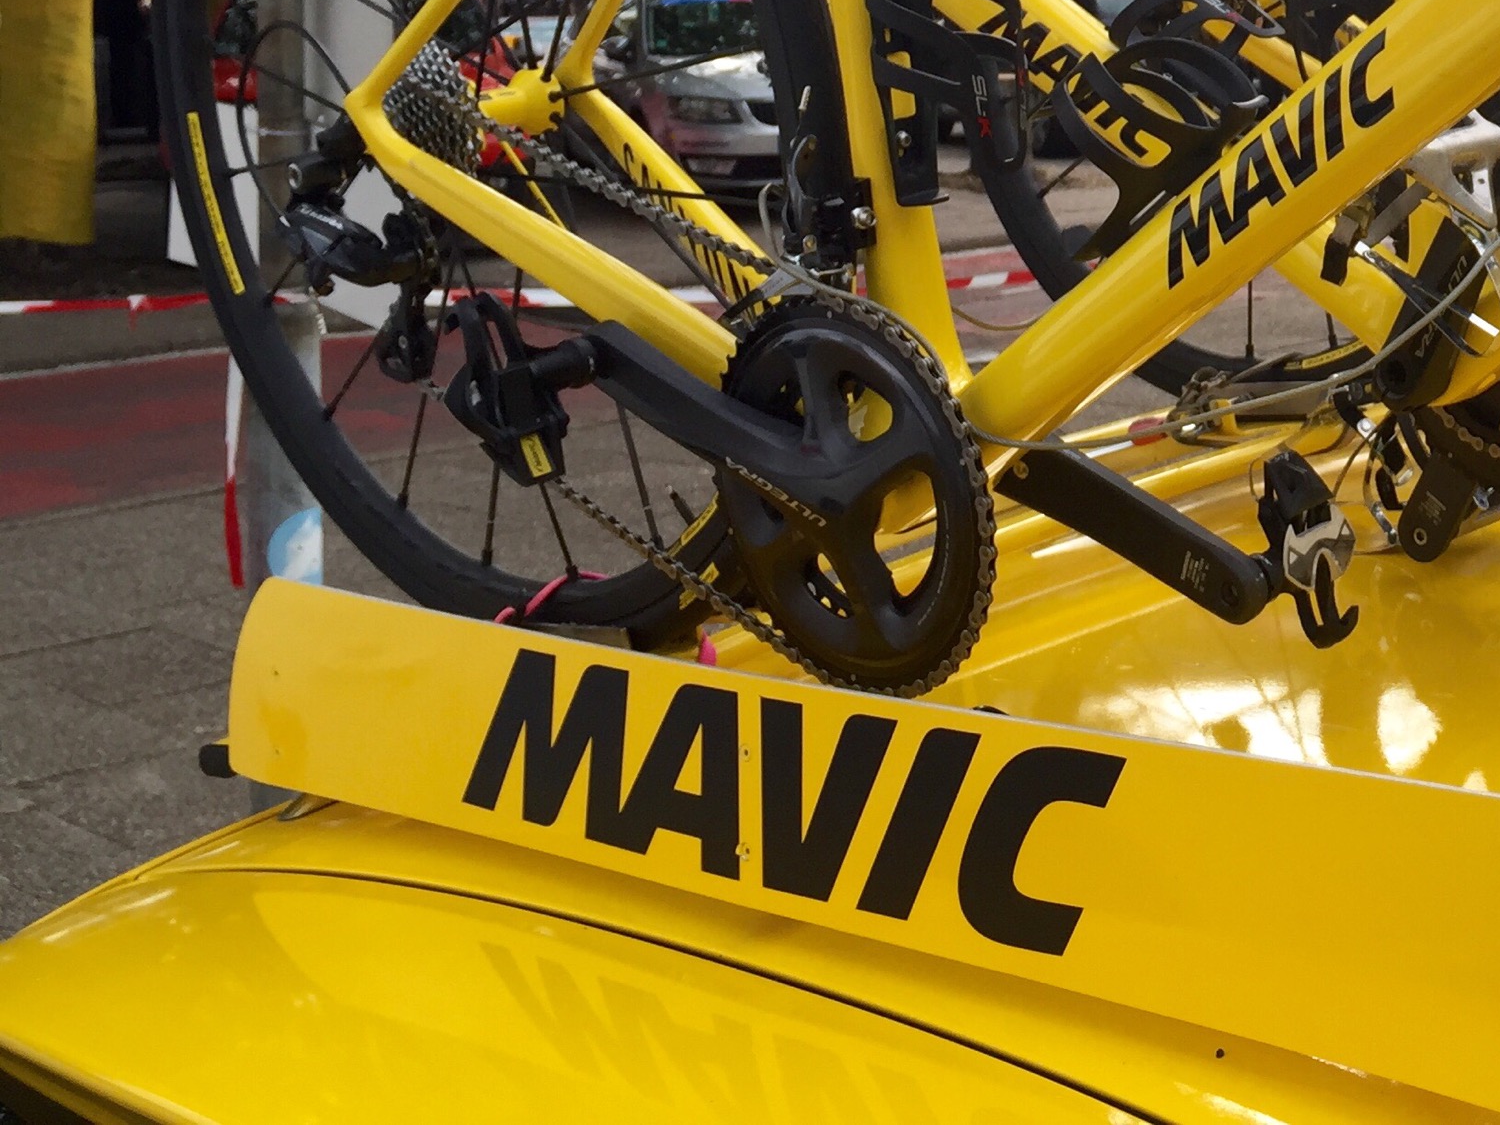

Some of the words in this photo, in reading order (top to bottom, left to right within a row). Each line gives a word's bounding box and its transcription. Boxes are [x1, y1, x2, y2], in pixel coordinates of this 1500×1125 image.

[1168, 27, 1395, 291] MAVIC
[725, 456, 828, 527] ULTEGRA
[461, 648, 1127, 957] MAVIC
